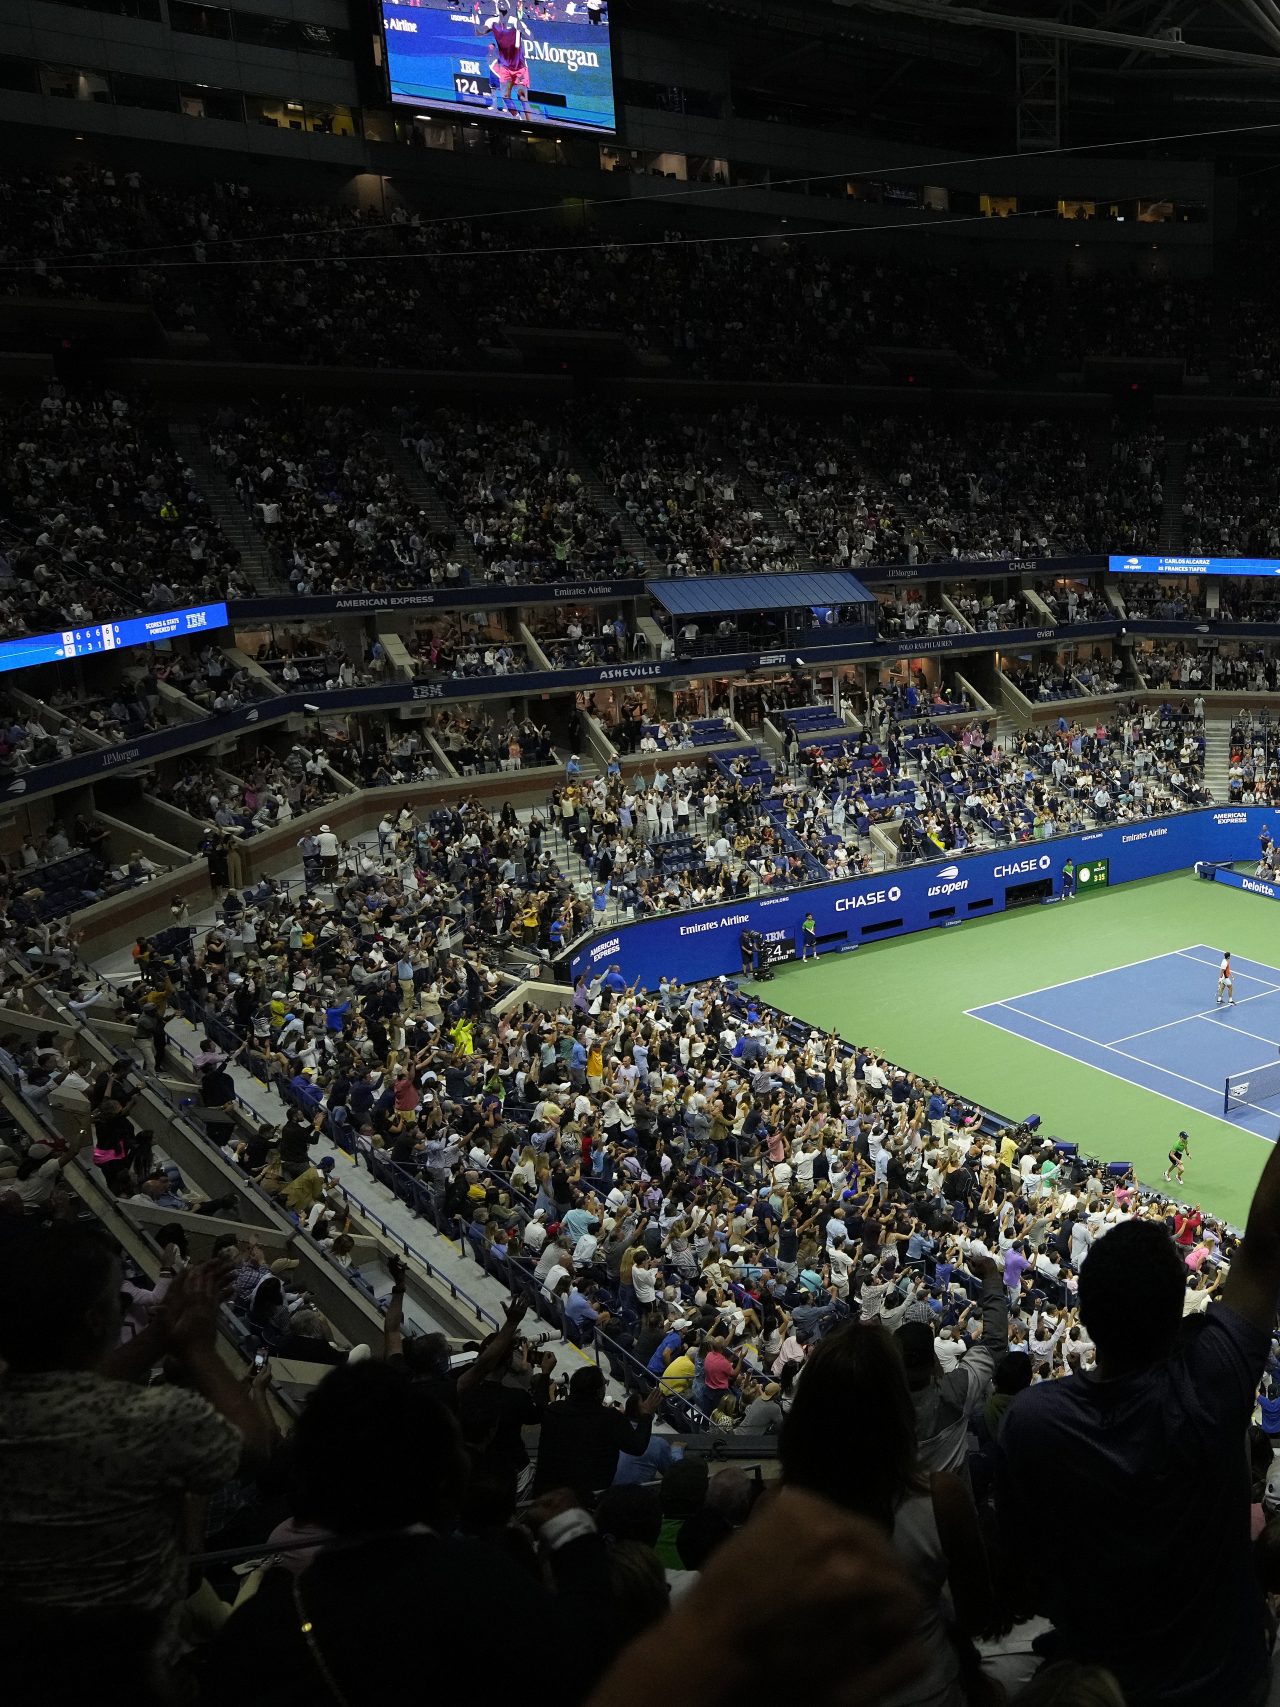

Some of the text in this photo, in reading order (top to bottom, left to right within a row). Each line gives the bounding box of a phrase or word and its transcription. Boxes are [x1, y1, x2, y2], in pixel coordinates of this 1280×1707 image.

[390, 17, 417, 33] Airline
[460, 60, 481, 75] IBM
[455, 78, 479, 95] 124
[1008, 562, 1036, 571] CHASE
[554, 585, 612, 597] Emirates Airline
[335, 596, 434, 608] AMERICAN EXPRESS
[185, 611, 207, 629] IBM
[76, 632, 81, 640] 6
[86, 630, 91, 638] 6
[114, 625, 119, 633] 0
[1036, 630, 1055, 638] evian
[87, 642, 92, 651] 3
[116, 637, 121, 645] 0
[759, 654, 786, 665] ESPN
[411, 684, 445, 699] IBM
[102, 747, 140, 767] J.P.Morgan
[1213, 812, 1247, 820] AMERICAN
[1122, 827, 1168, 843] Emirates Airline
[993, 858, 1038, 878] CHASE
[927, 880, 969, 897] us open
[1242, 878, 1275, 896] Deloitte.
[835, 890, 886, 912] CHASE
[680, 914, 750, 936] Emirates Airline
[766, 930, 787, 942] IBM
[590, 937, 619, 957] AMERICAN
[593, 945, 620, 963] EXPRESS
